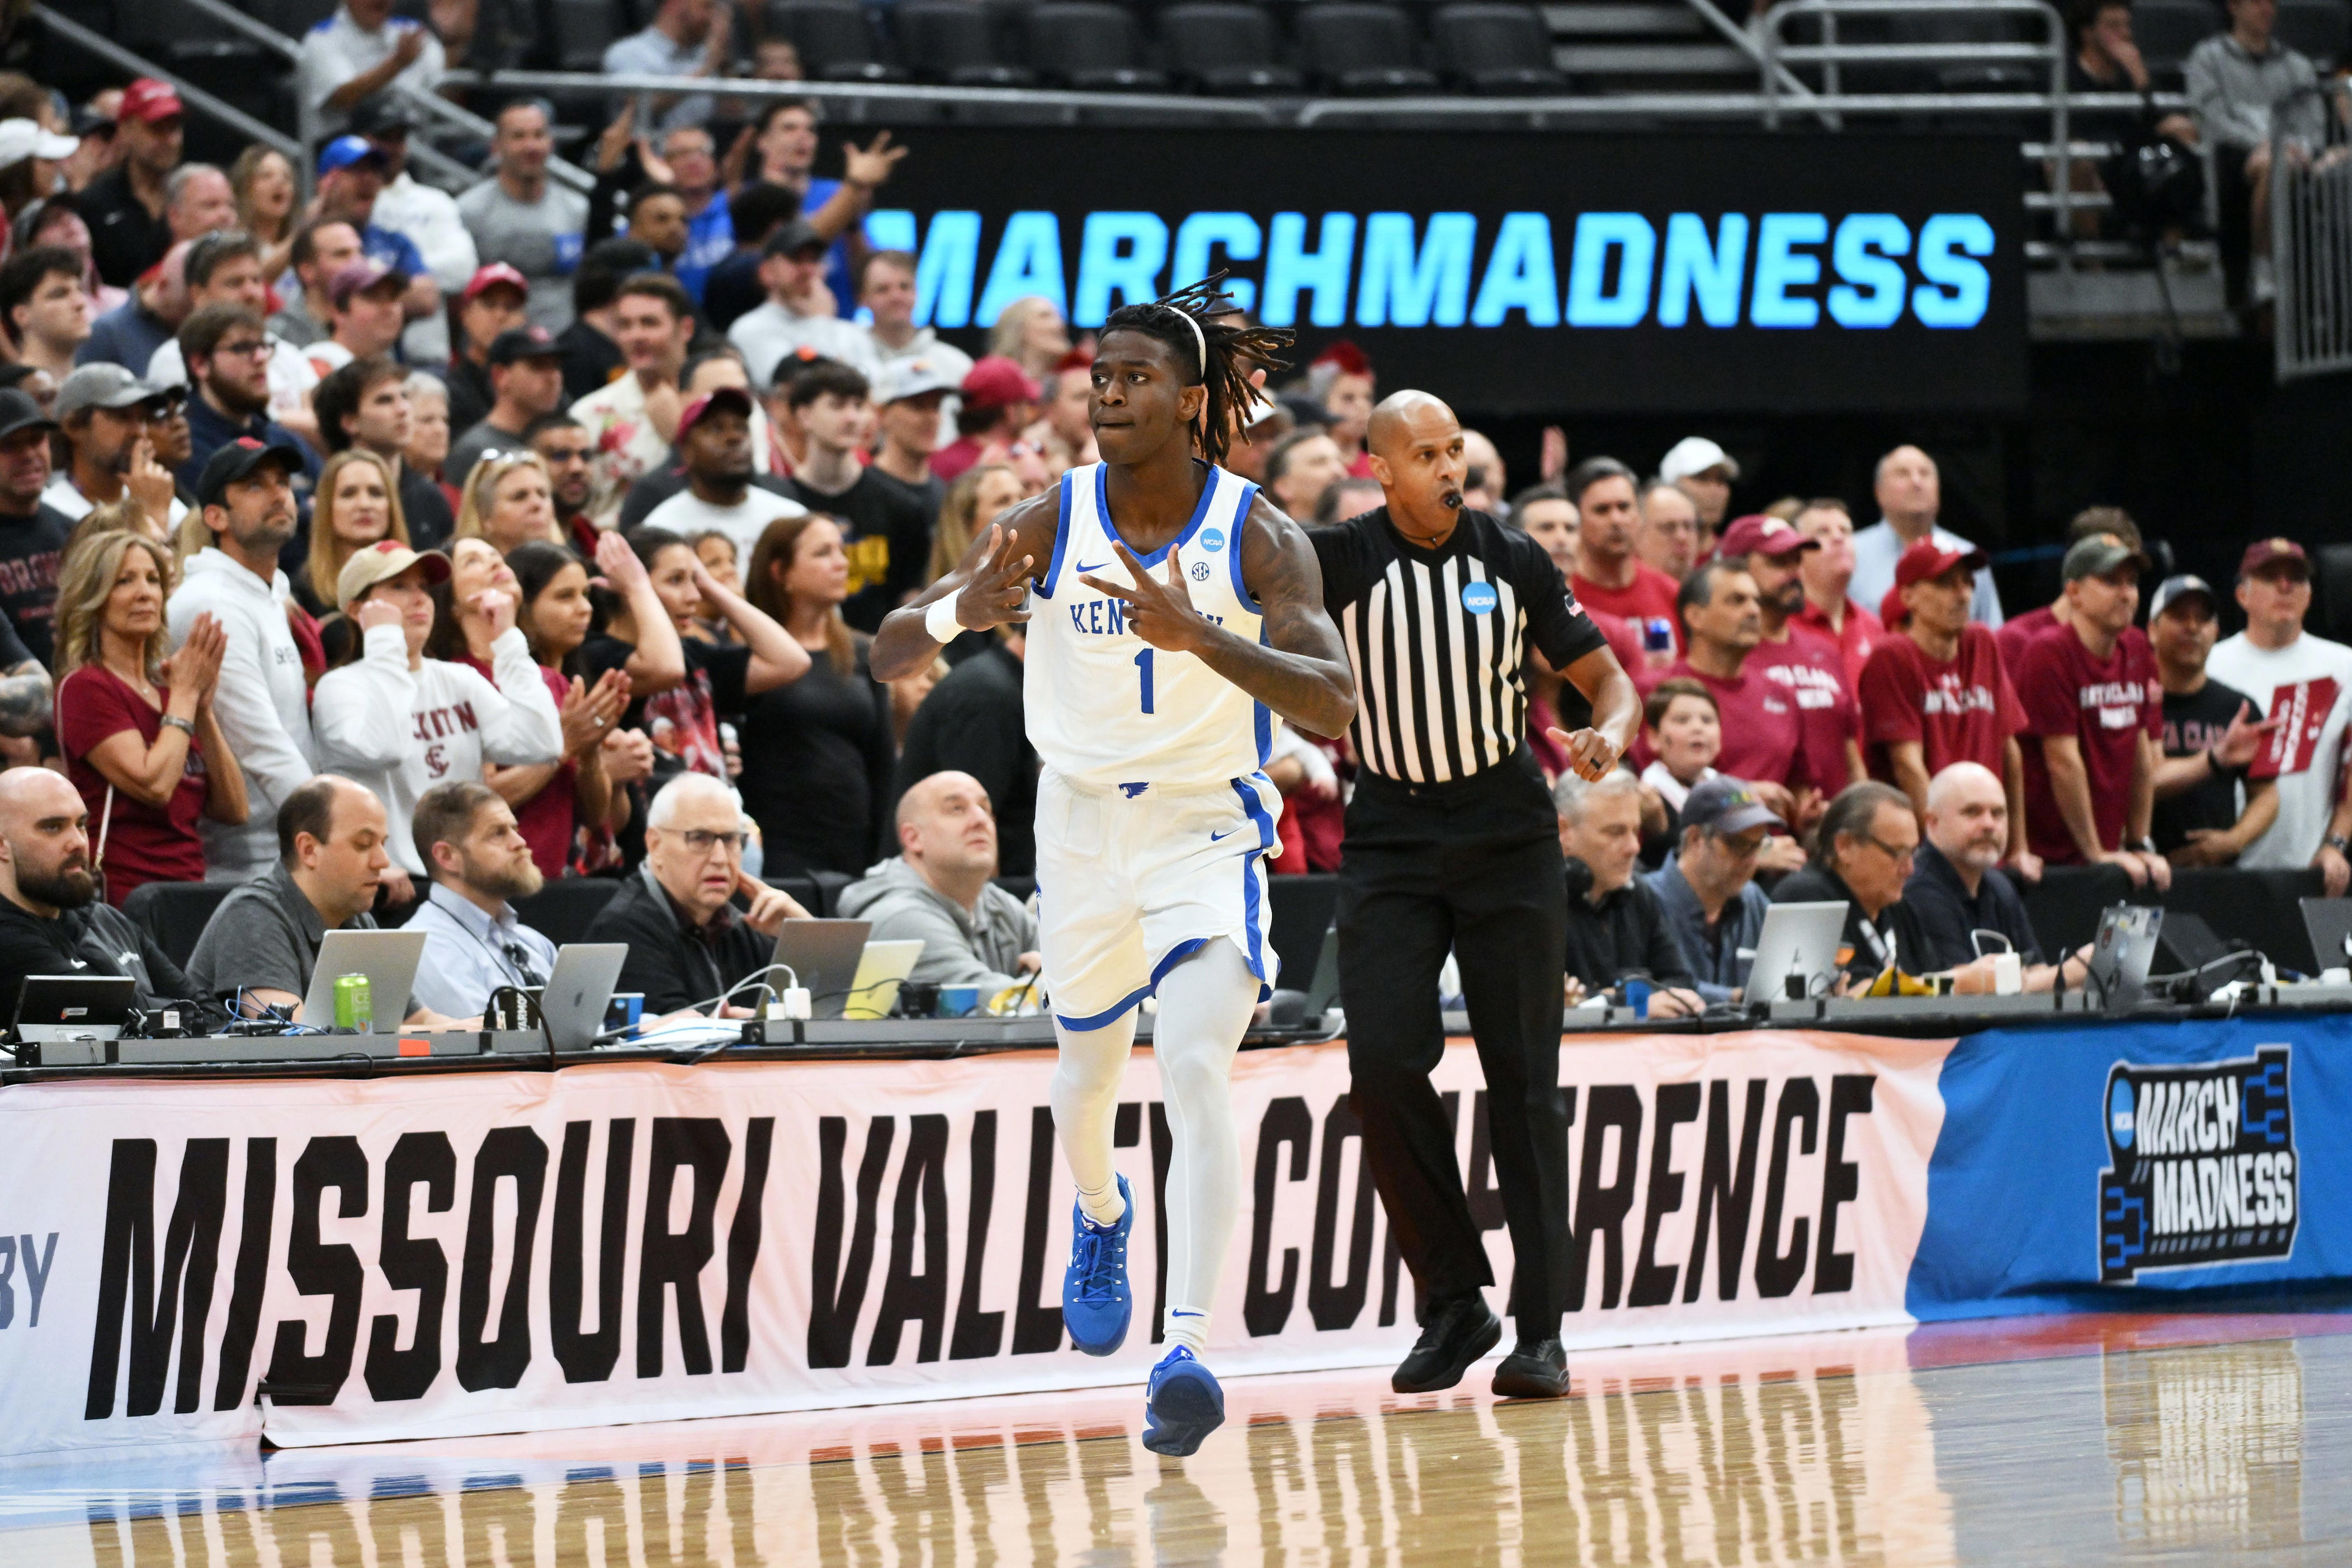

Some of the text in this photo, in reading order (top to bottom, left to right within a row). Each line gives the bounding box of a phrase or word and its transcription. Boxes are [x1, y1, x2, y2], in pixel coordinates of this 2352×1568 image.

[854, 209, 1995, 329] MARCHMADNESS
[1192, 562, 1209, 580] SEC
[1467, 596, 1496, 607] NCAA
[1134, 648, 1155, 714] 1
[2134, 1075, 2239, 1156] MARCH
[2153, 1151, 2293, 1236] MADNESS
[85, 1116, 776, 1420] MISSOURI
